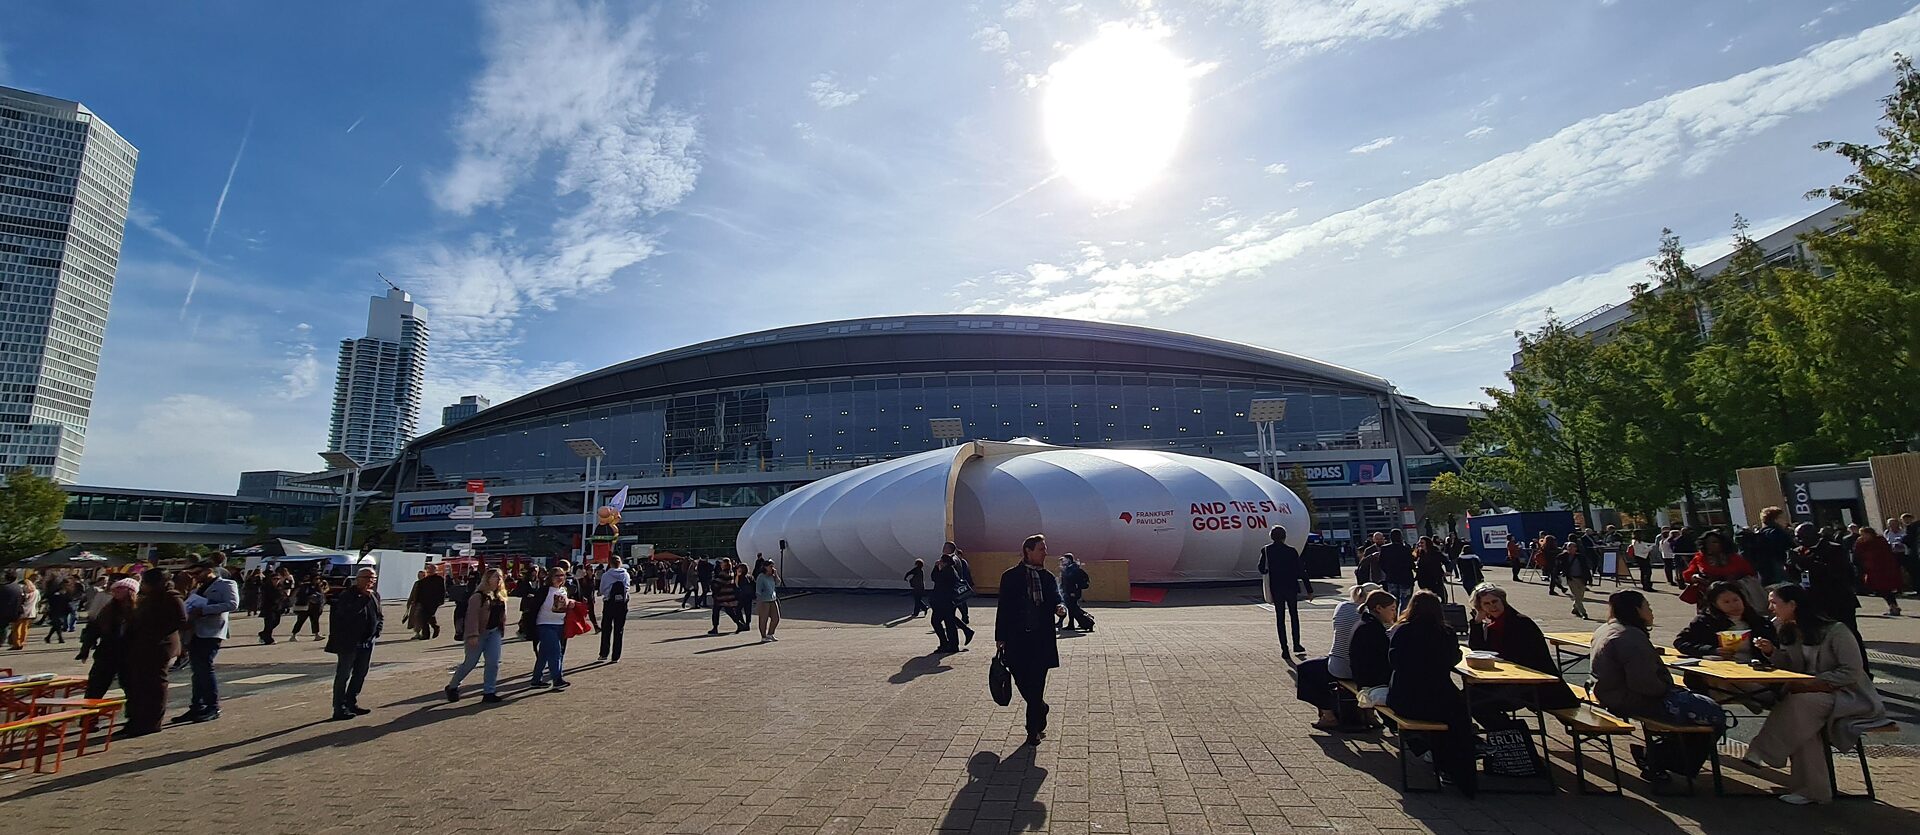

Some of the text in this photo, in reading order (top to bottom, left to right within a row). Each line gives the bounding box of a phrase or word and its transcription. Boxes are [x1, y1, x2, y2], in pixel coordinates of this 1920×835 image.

[1190, 502, 1227, 515] AND
[1230, 501, 1258, 513] THE
[1192, 515, 1268, 531] GOES ON
[1489, 734, 1524, 746] ERLIN
